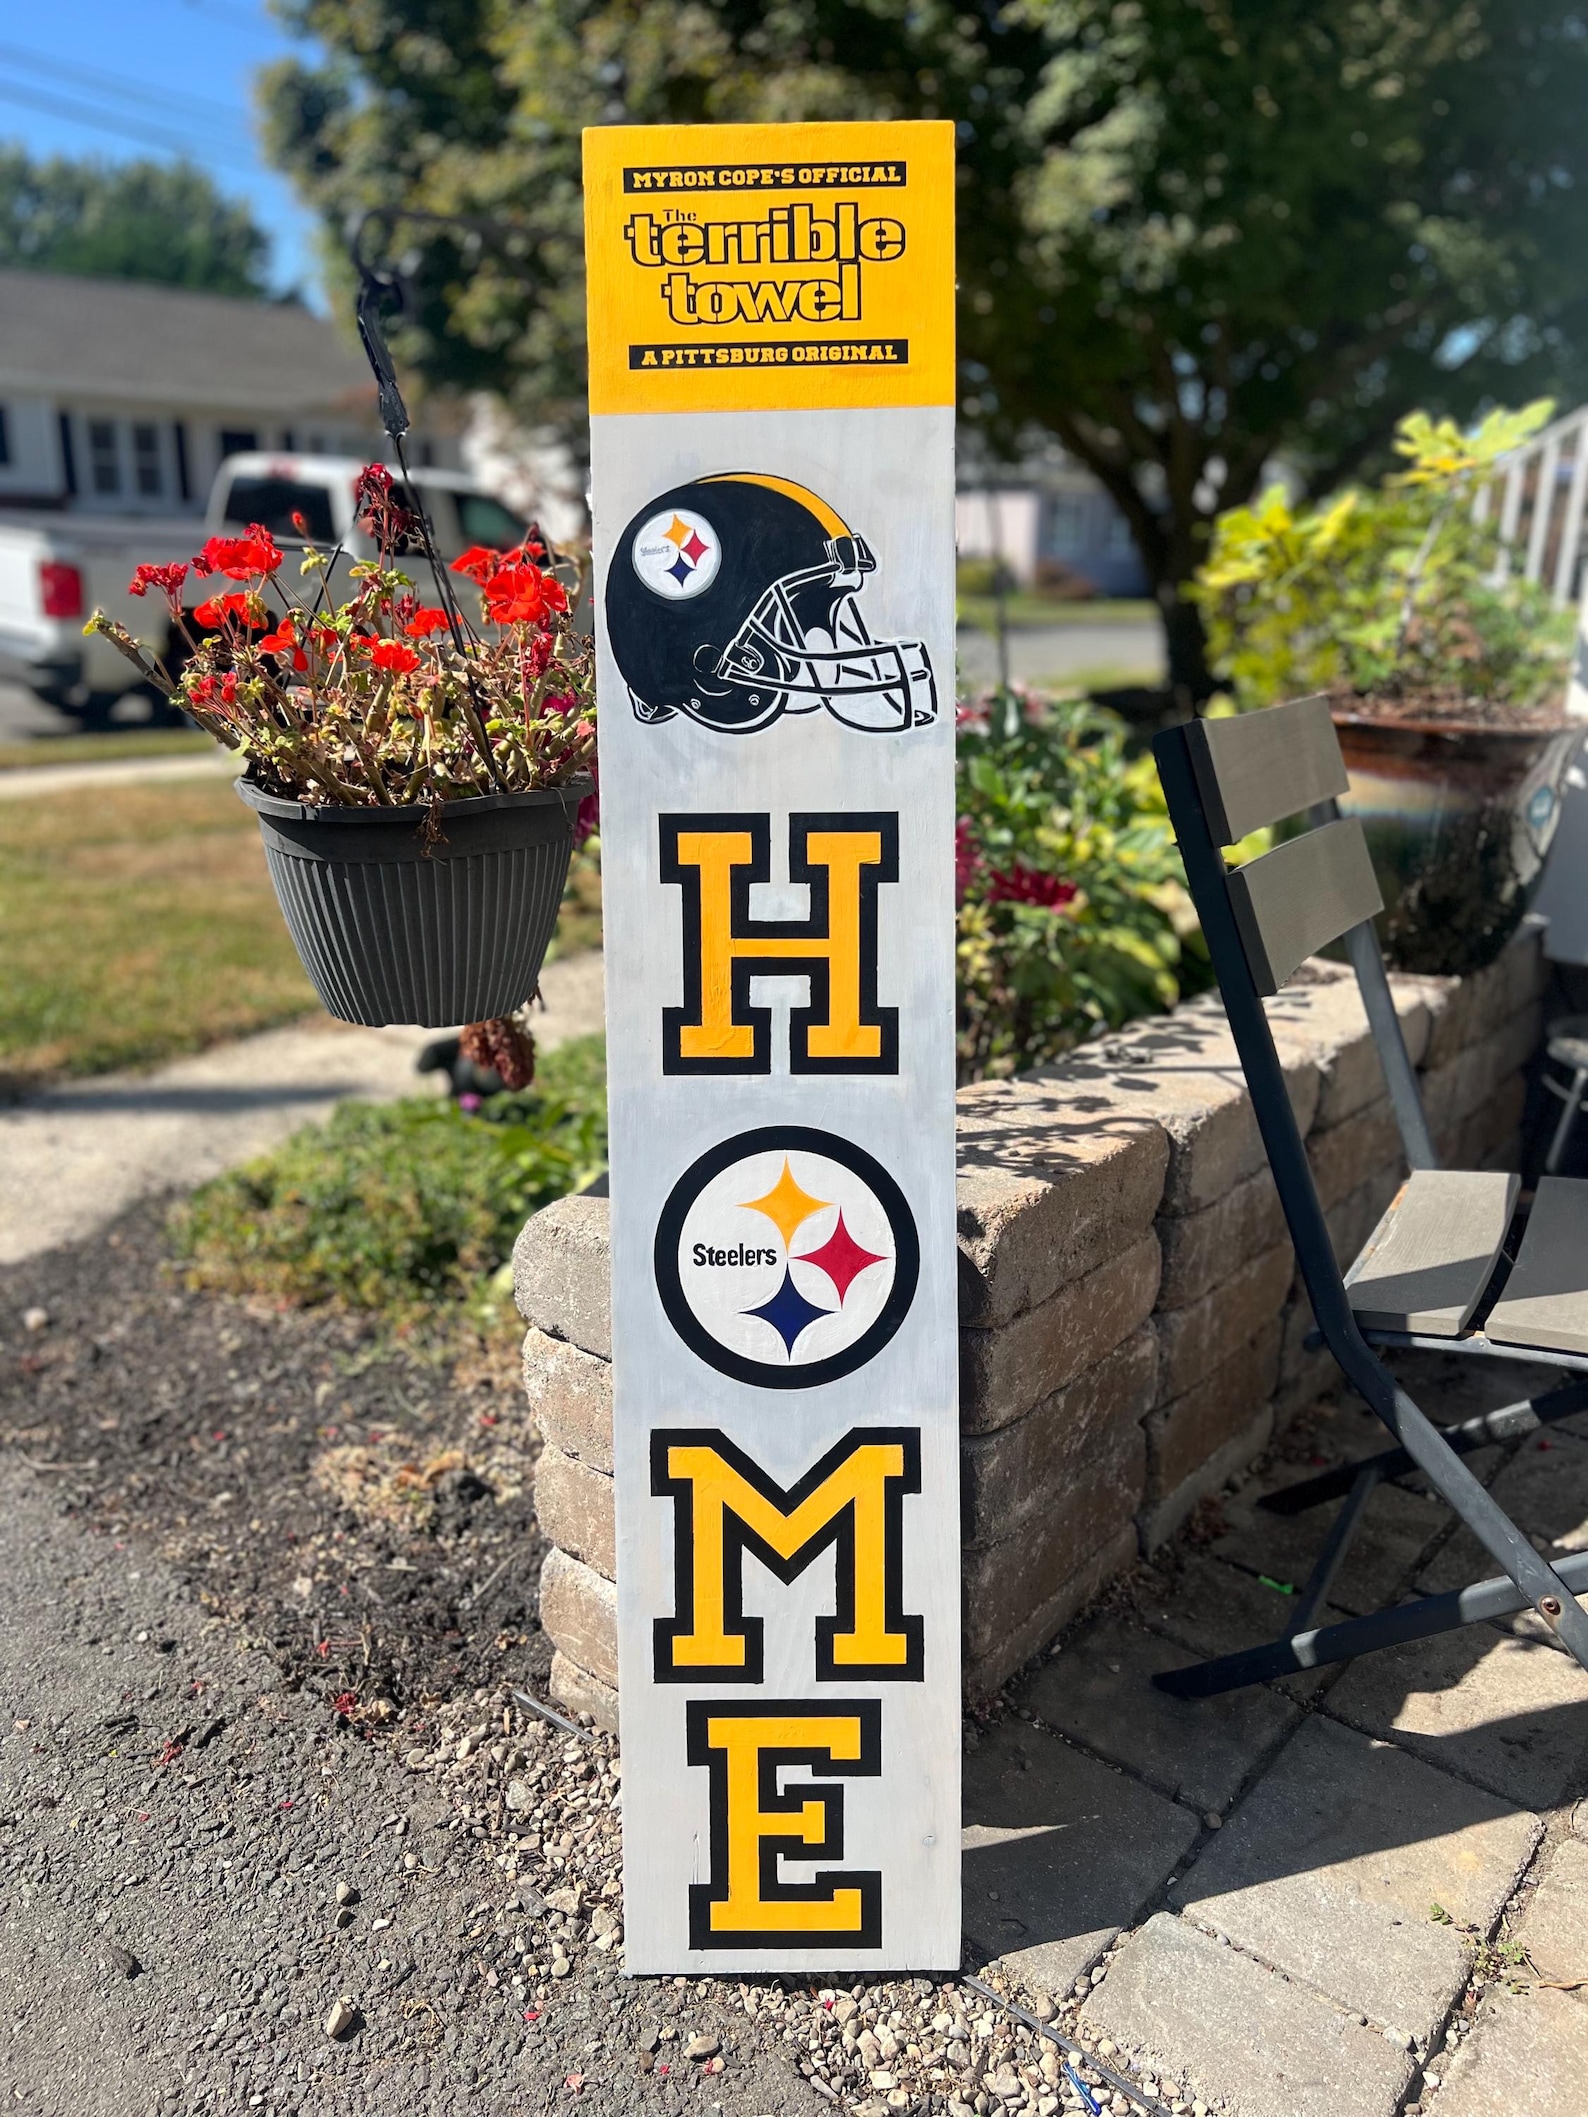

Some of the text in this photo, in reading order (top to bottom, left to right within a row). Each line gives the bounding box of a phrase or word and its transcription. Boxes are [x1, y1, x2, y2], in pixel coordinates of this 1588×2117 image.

[633, 166, 901, 188] MYRON COPE'S OFFICIAL
[662, 208, 697, 223] The
[624, 202, 906, 266] terrible
[661, 261, 862, 325] towel
[641, 345, 898, 366] A PITTSBURG ORIGINAL
[692, 1243, 777, 1266] Steelers
